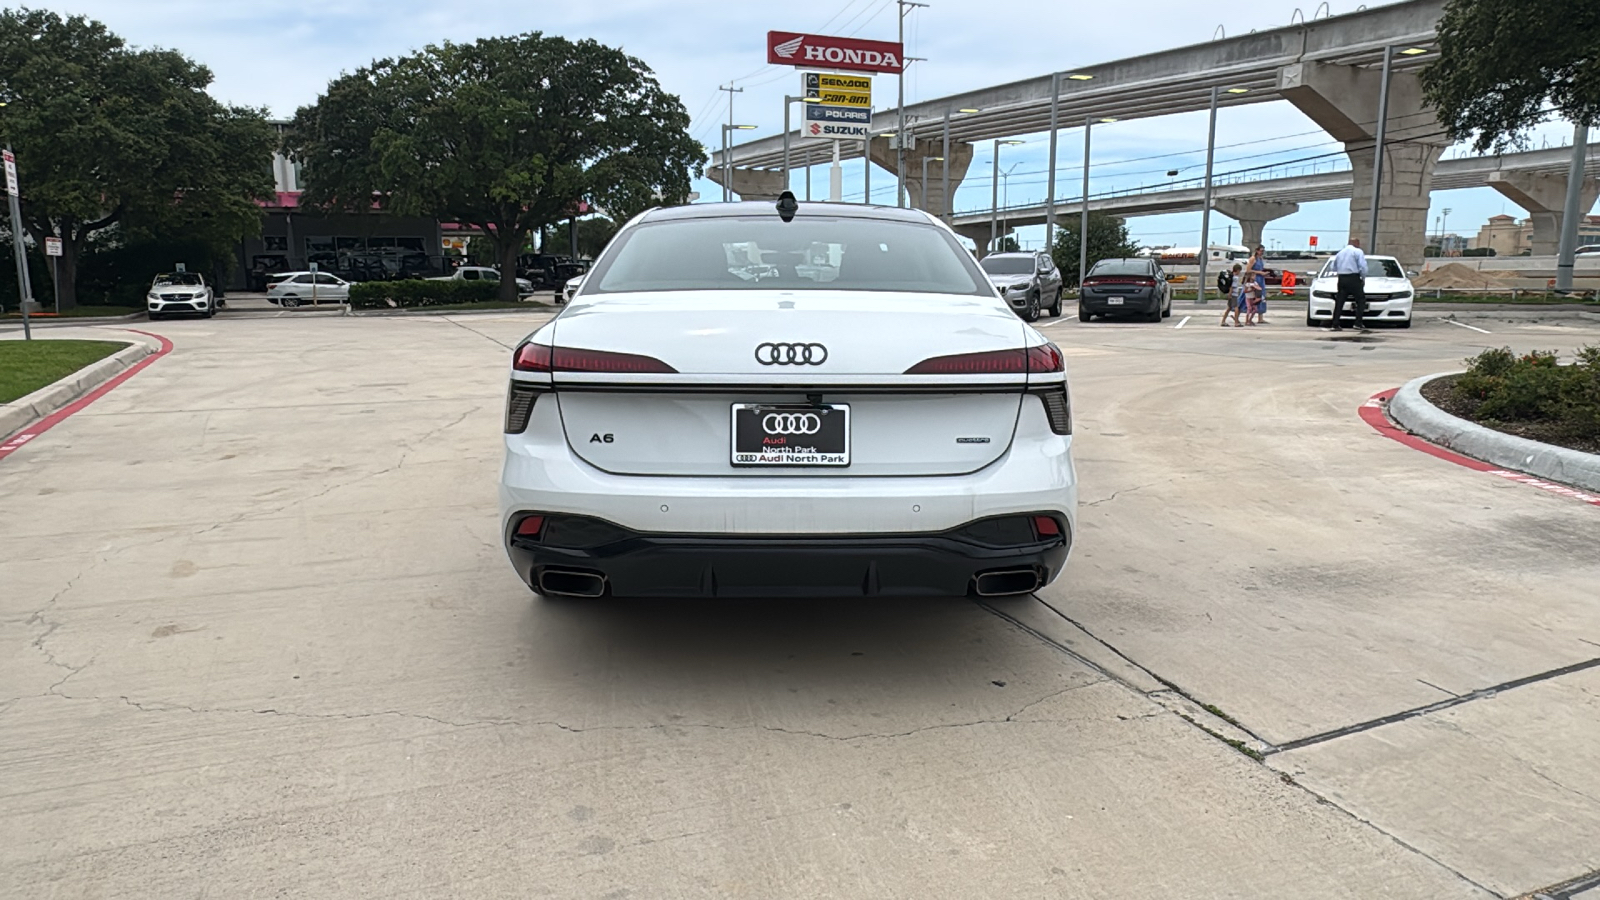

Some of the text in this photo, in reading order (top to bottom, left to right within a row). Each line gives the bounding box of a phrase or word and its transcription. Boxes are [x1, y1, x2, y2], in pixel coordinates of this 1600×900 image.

[804, 45, 901, 67] HONDA
[825, 110, 867, 120] POLARIS
[823, 125, 868, 136] SUZUKI
[589, 433, 614, 443] A6
[763, 437, 787, 445] Audi
[762, 446, 817, 454] North Park
[758, 454, 845, 463] Audi North Park
